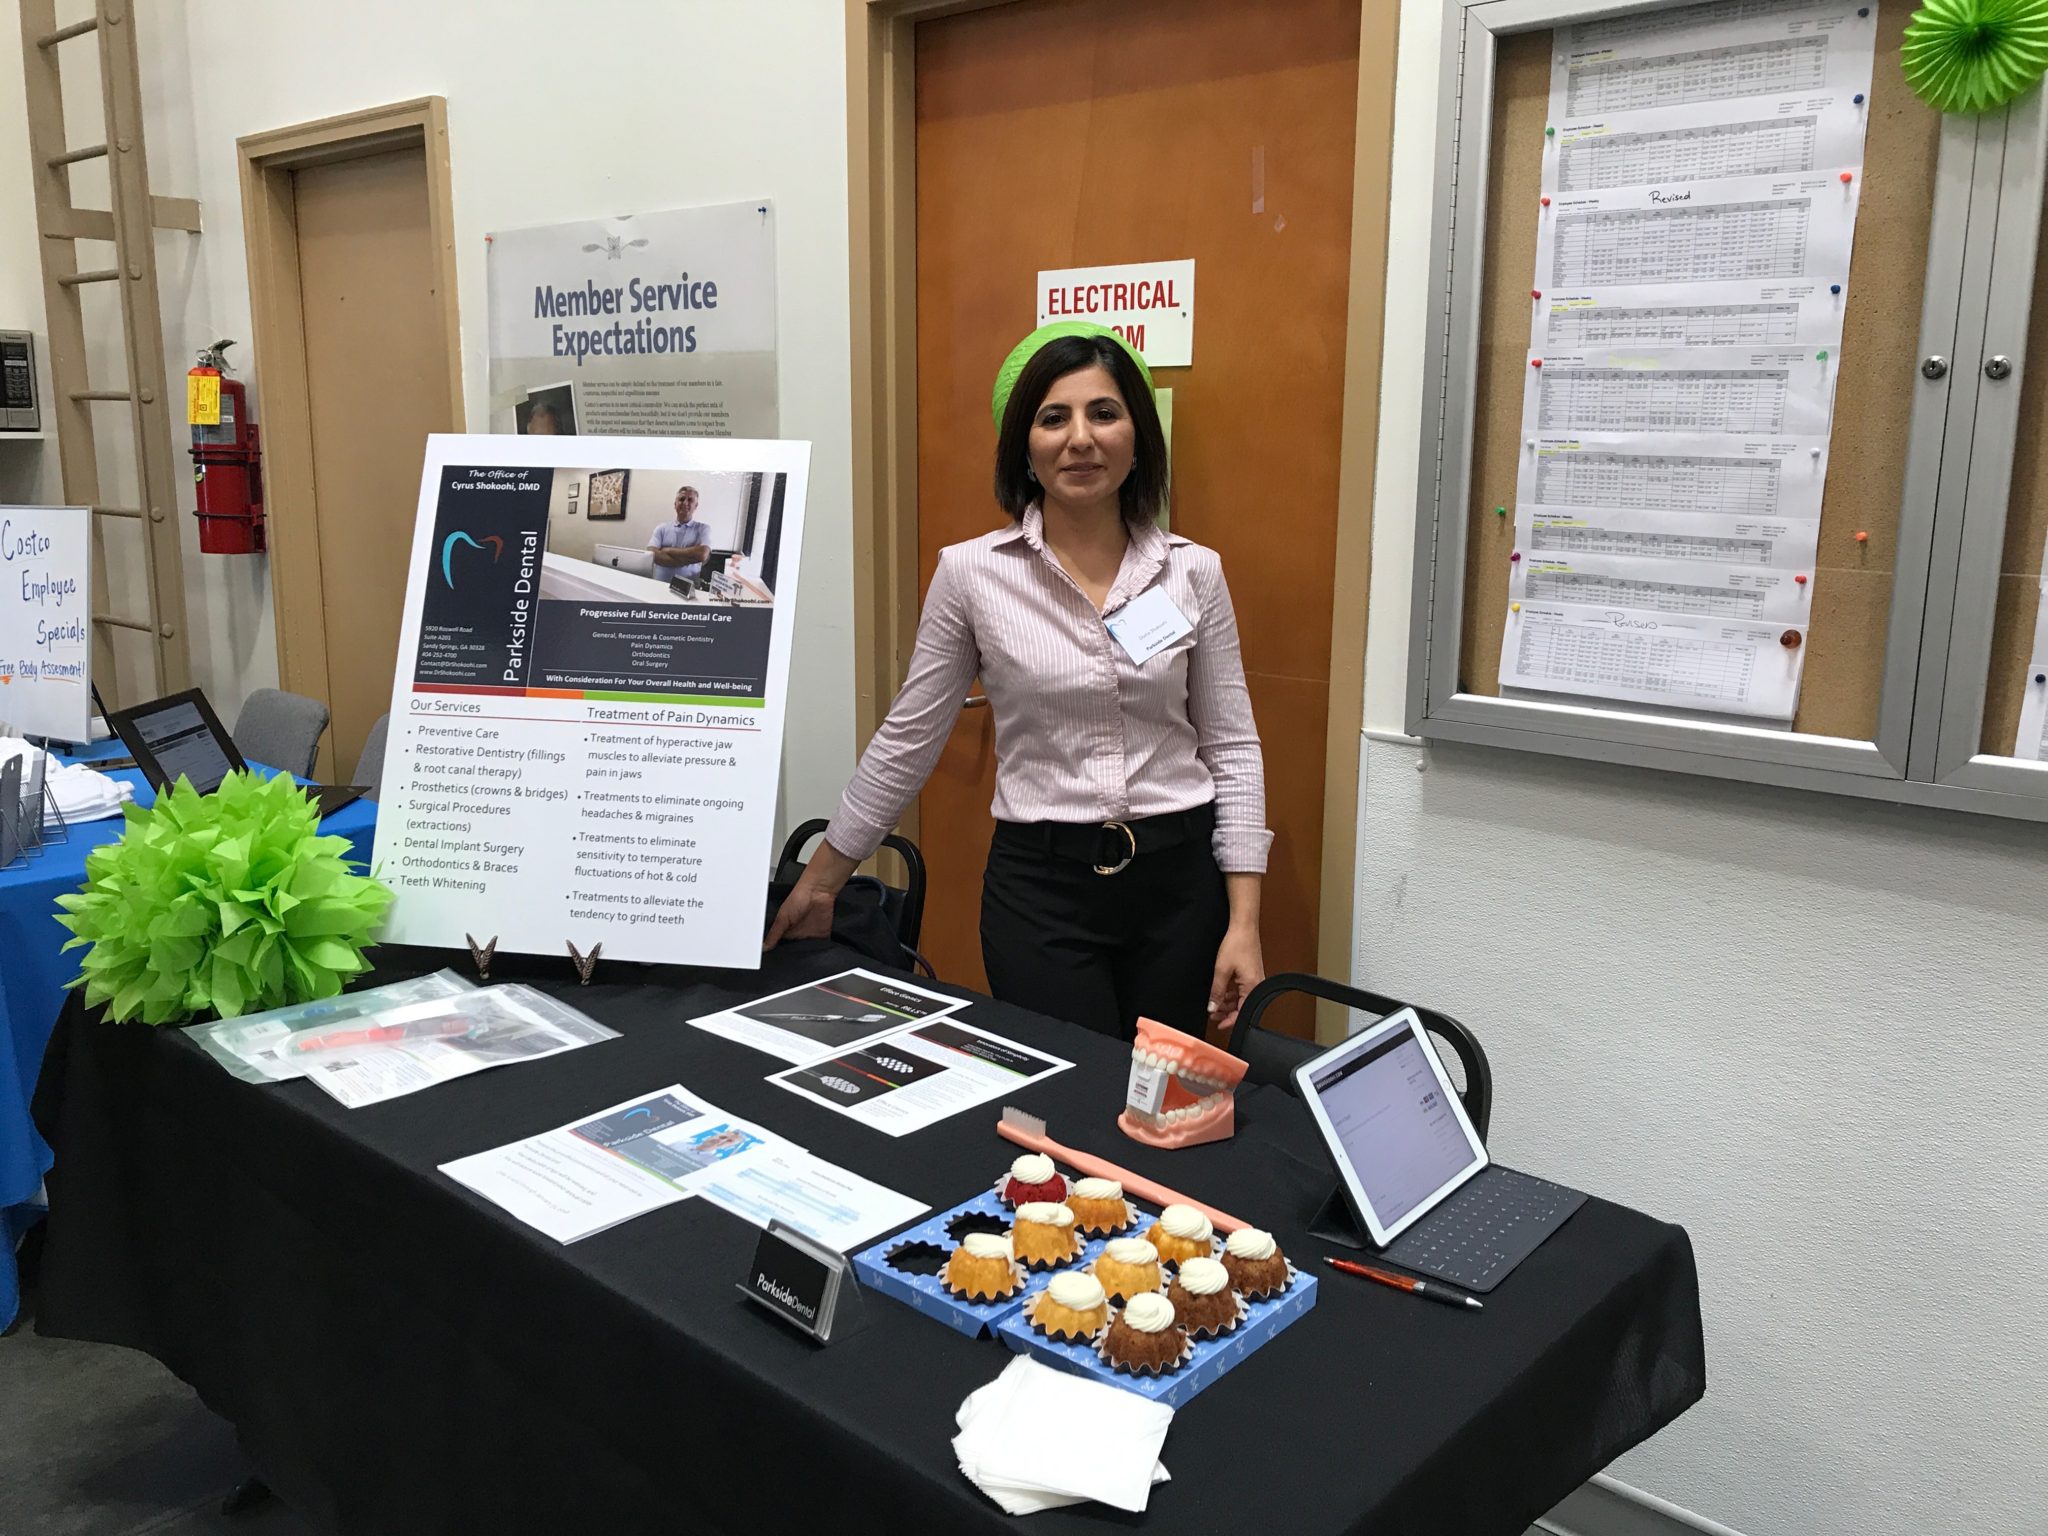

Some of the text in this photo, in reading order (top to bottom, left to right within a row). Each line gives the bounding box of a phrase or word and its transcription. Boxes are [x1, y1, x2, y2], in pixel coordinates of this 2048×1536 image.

[1648, 191, 1690, 204] Revised
[534, 271, 718, 318] Member Service
[1049, 280, 1180, 315] ELECTRICAL
[552, 316, 697, 367] Expectations
[469, 470, 529, 479] The Office of
[452, 481, 474, 490] Cyrus
[476, 482, 517, 491] Shokoohi,
[2, 520, 50, 560] Costco
[22, 569, 76, 606] Employee
[504, 531, 538, 681] Parkside Dental
[580, 608, 732, 622] Progressive Full Service Dental Care
[36, 617, 85, 653] Specials
[618, 632, 651, 640] Restorative
[659, 634, 686, 642] Cosmetic
[687, 636, 714, 644] Dentistry
[632, 651, 670, 659] Orthodontics
[645, 642, 673, 651] Dynamics
[19, 660, 38, 682] Body
[546, 674, 752, 691] With Consideration For Your Overall Health and Well-being
[410, 699, 480, 712] Our Services
[587, 707, 755, 726] Treatment of Pain Dynamics
[418, 725, 499, 739] Preventive Care
[590, 733, 732, 751] Treatment of hyperactive jaw
[416, 744, 565, 763] Restorative Dentistry (fillings
[588, 750, 736, 766] muscles to alleviate pressure &
[414, 763, 522, 780] & root canal therapy)
[586, 768, 642, 780] pain in jaws
[411, 781, 568, 801] Prosthetics (crowns & bridges)
[409, 800, 511, 815] Surgical Procedures
[584, 790, 744, 811] Treatments to eliminate ongoing
[581, 808, 694, 824] headaches & migraines
[406, 819, 471, 833] (extractions)
[404, 837, 524, 856] Dental Implant Surgery
[579, 832, 696, 848] Treatments to eliminate
[402, 856, 518, 873] Orthodontics & Braces
[576, 850, 702, 867] sensitivity to temperature
[575, 866, 697, 883] fluctuations of hot & cold
[400, 875, 486, 892] Teeth Whitening
[572, 890, 704, 908] Treatments to alleviate the
[570, 908, 684, 925] tendency to grind teeth
[757, 1272, 816, 1320] ParksideDental
